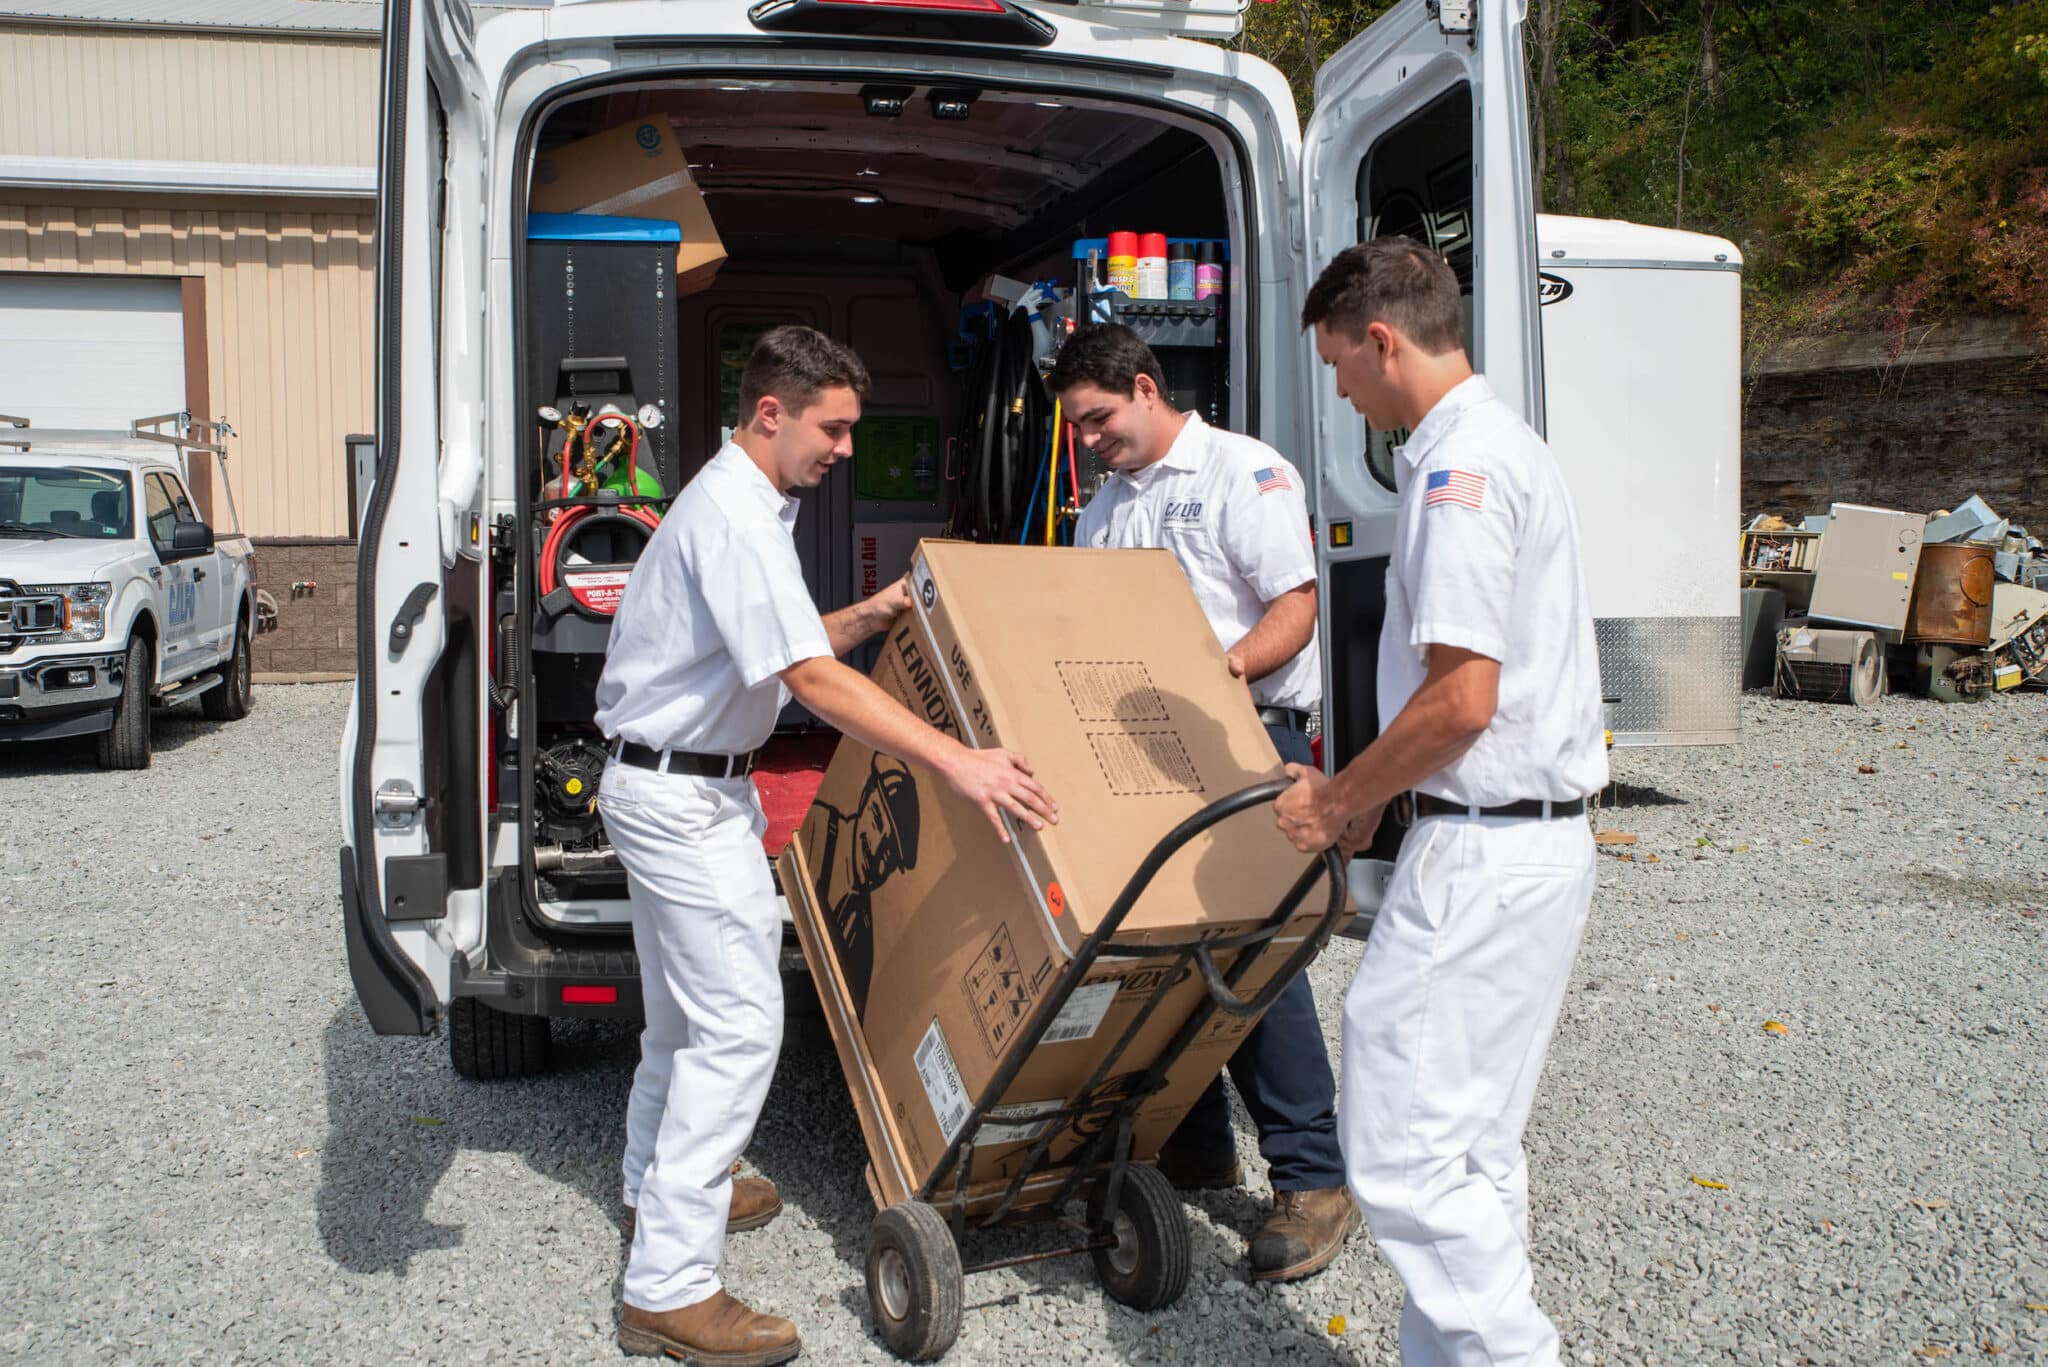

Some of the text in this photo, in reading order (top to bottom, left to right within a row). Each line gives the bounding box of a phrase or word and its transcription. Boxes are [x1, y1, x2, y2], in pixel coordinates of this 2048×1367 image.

[862, 537, 877, 597] First Aid
[895, 625, 954, 733] LENNOX
[951, 644, 972, 691] USE
